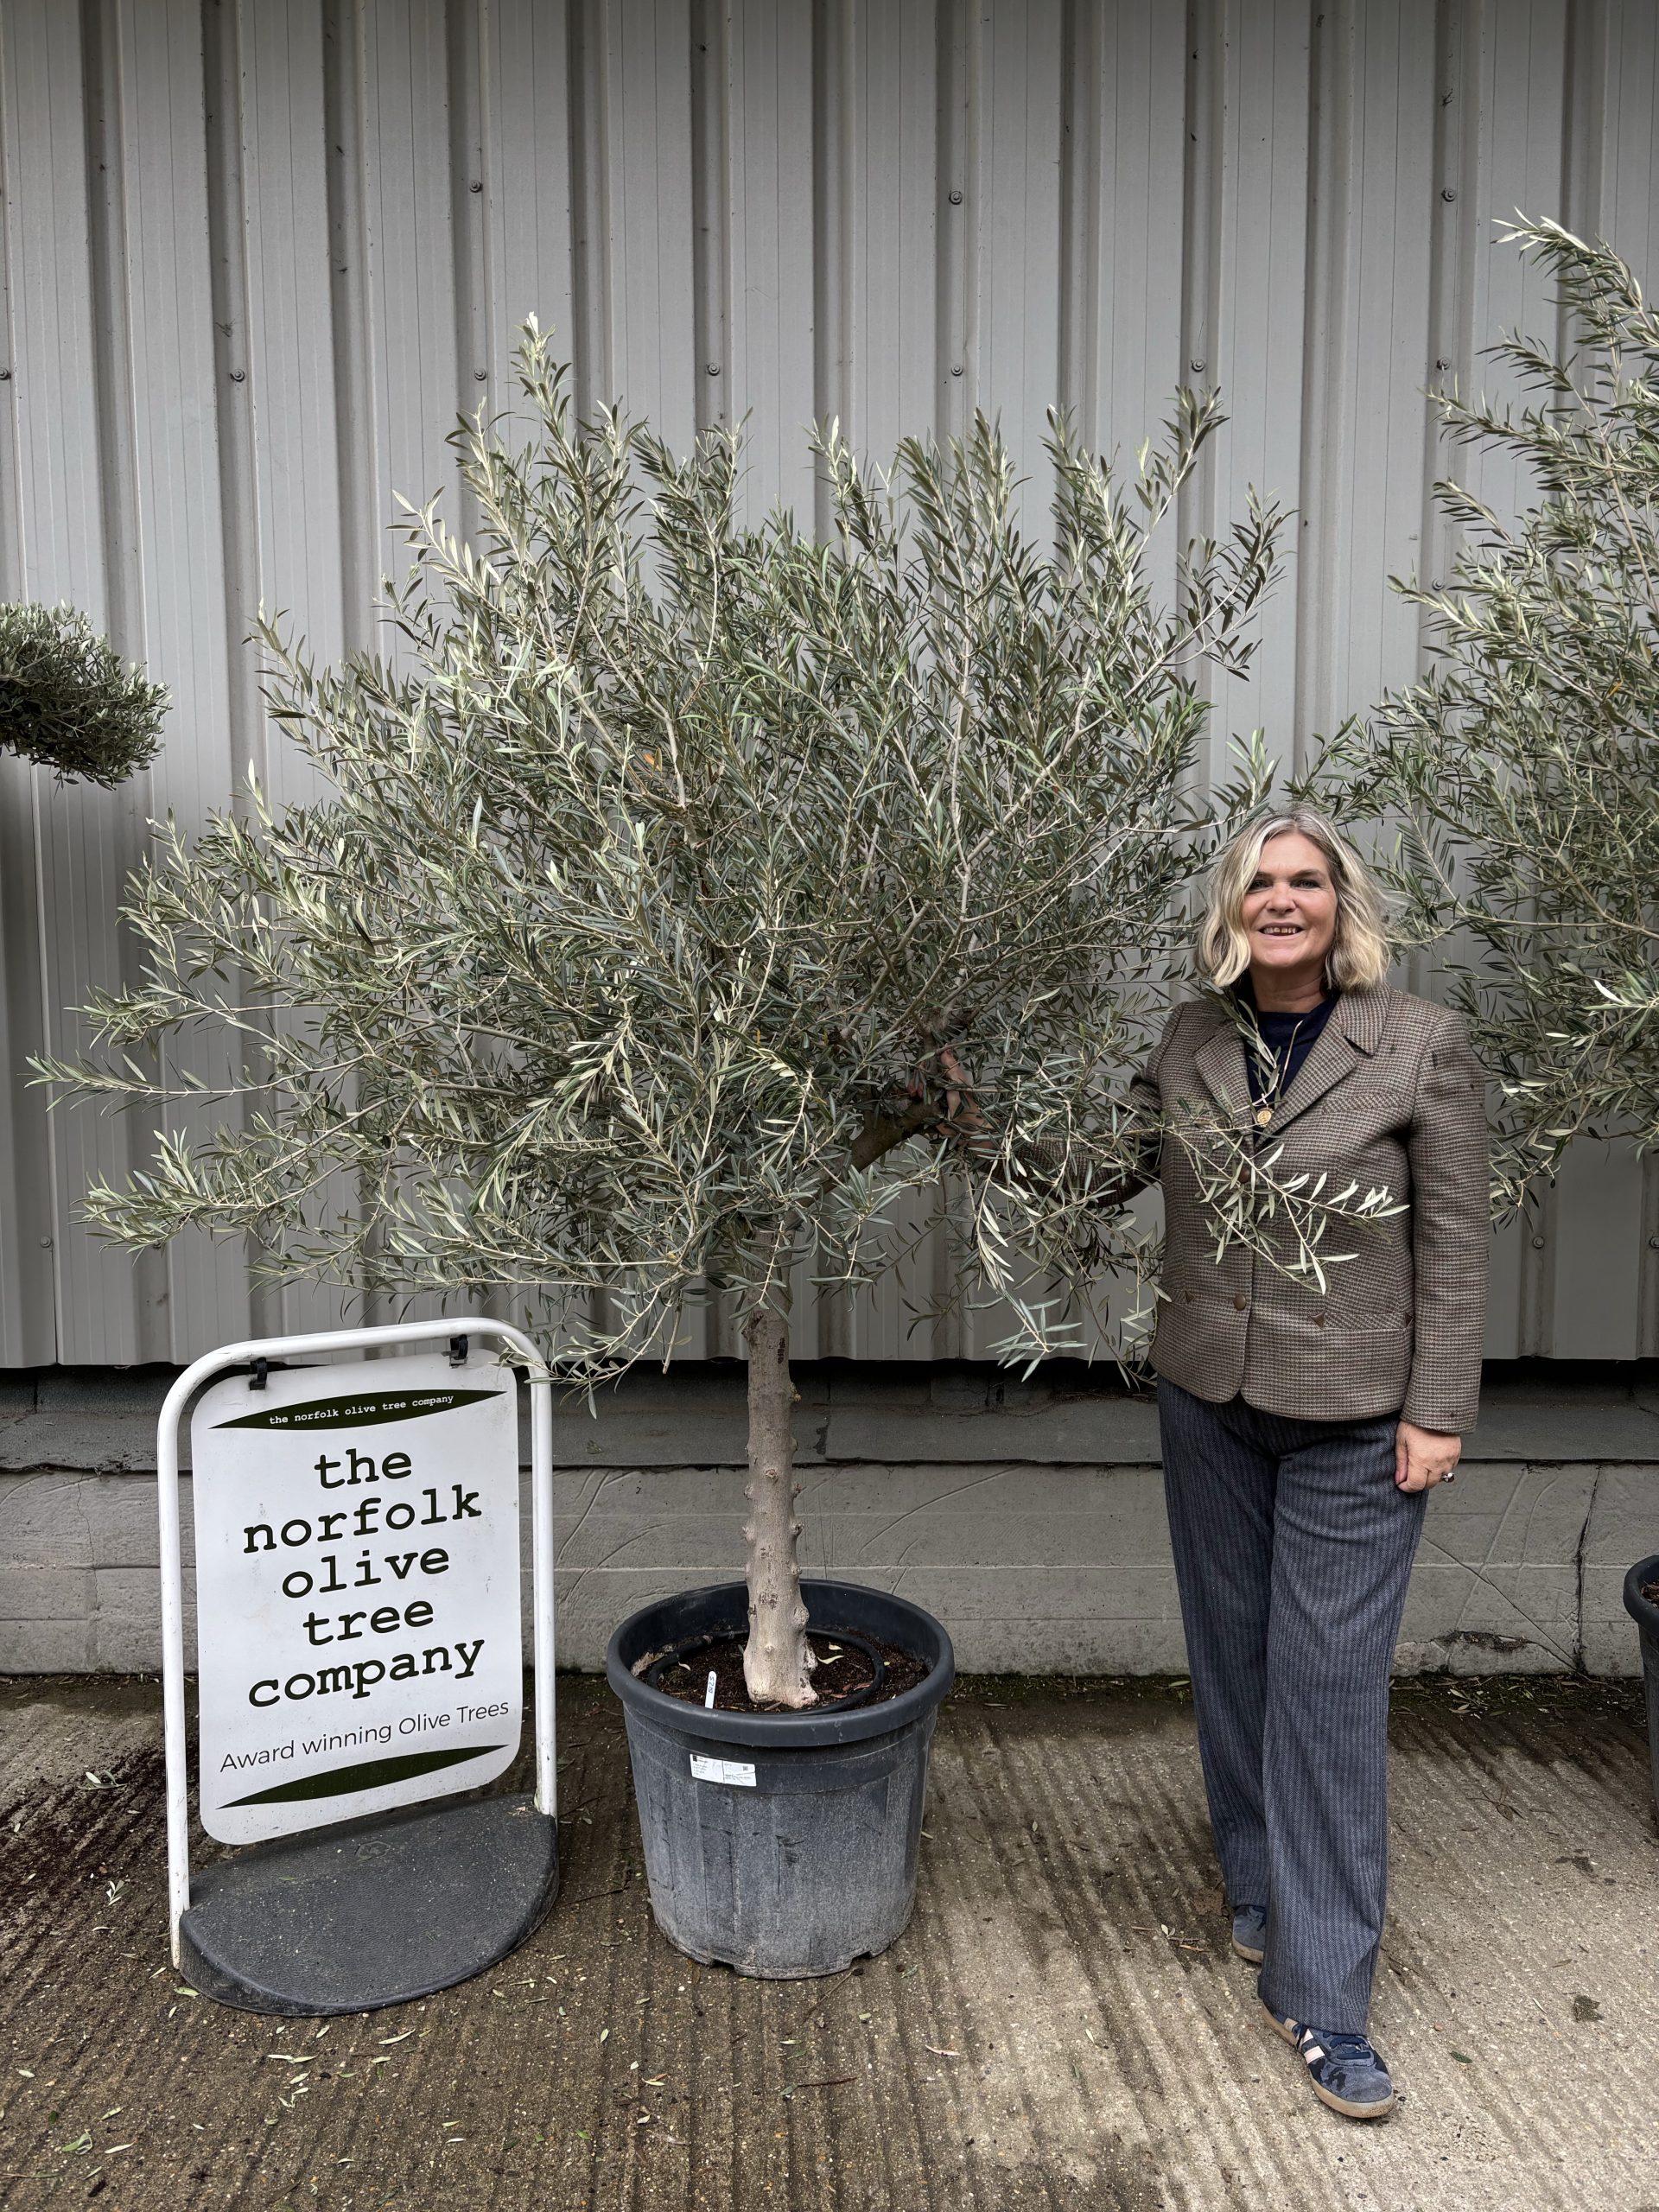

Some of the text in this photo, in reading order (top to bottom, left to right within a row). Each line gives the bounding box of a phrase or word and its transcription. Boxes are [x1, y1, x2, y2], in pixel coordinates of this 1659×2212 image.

[270, 1395, 454, 1425] the norfolk olive tree company
[314, 1448, 412, 1489] the
[244, 1484, 482, 1554] norfolk
[282, 1548, 449, 1599] olive
[303, 1600, 434, 1646] tree
[248, 1640, 485, 1707] company
[219, 1702, 509, 1773] Award winning Olive Trees
